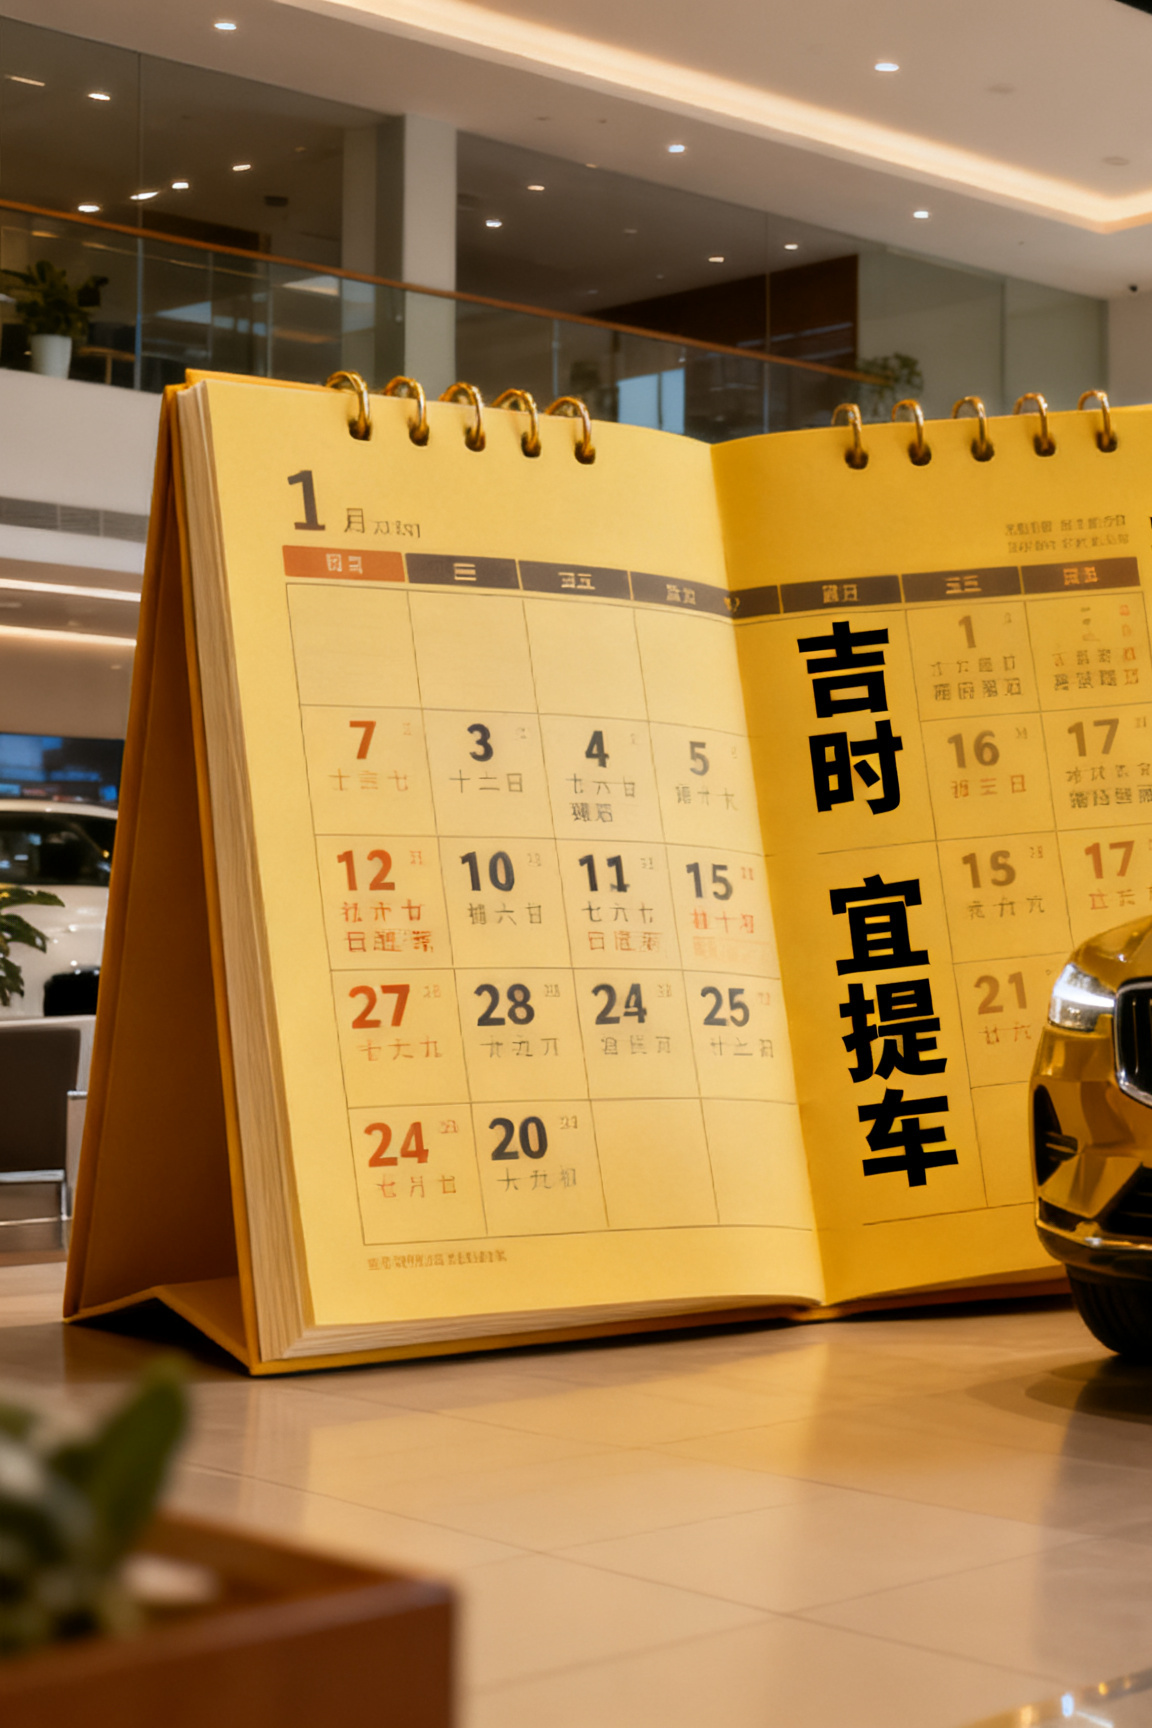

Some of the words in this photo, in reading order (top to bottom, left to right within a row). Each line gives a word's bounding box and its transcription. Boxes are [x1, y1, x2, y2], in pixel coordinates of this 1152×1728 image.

[287, 470, 326, 531] 1
[958, 615, 977, 649] 1
[797, 621, 903, 815] 吉时
[1067, 718, 1120, 758] 17
[349, 720, 376, 760] 7
[467, 723, 494, 762] 3
[585, 730, 610, 768] 4
[689, 741, 710, 776] 5
[947, 730, 1000, 769] 16
[337, 849, 396, 891] 12
[460, 850, 515, 892] 10
[578, 854, 630, 892] 11
[1084, 840, 1135, 879] 17
[686, 862, 733, 901] 15
[348, 984, 410, 1029] 27
[474, 983, 535, 1027] 28
[591, 983, 647, 1025] 24
[700, 986, 750, 1027] 25
[974, 971, 1027, 1016] 21
[829, 874, 959, 1187] 宜提车
[364, 1121, 429, 1168] 24
[489, 1116, 548, 1161] 20
